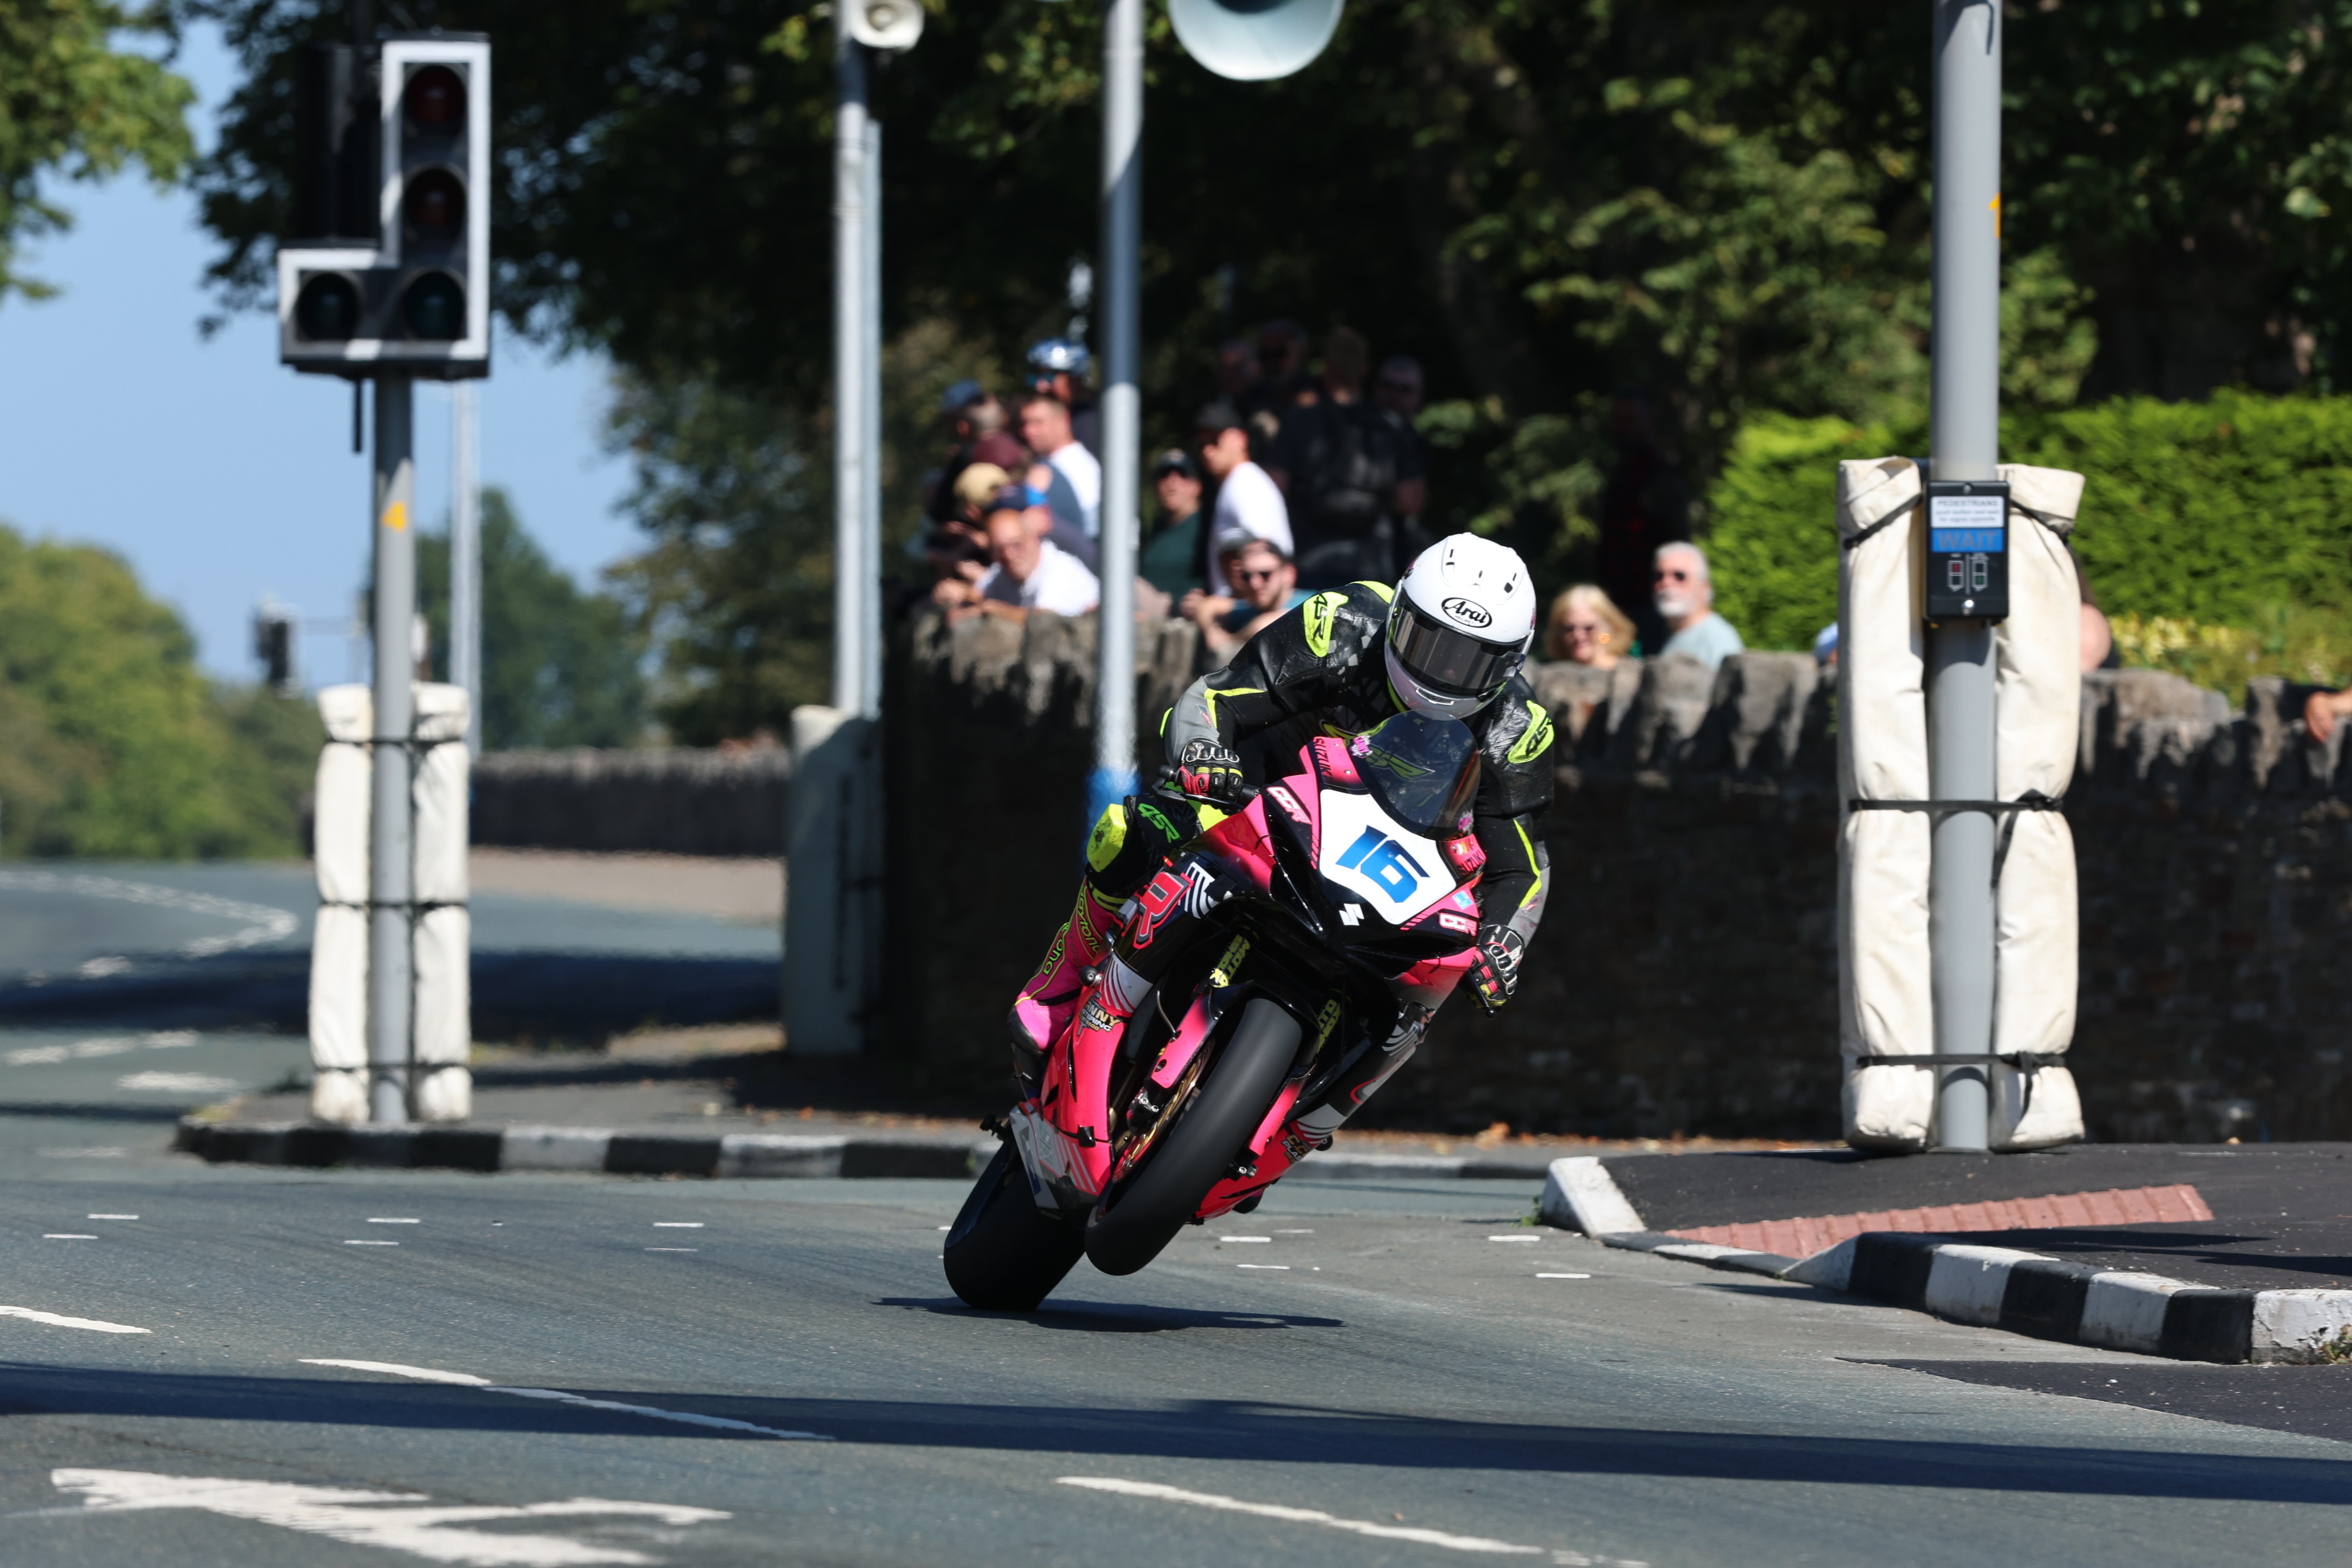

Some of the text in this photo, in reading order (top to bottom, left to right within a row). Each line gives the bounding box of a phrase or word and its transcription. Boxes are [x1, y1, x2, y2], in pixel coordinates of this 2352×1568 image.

[1937, 532, 1998, 549] WAIT
[1443, 601, 1489, 623] Arai
[1266, 786, 1312, 824] CCR
[1138, 803, 1181, 843] 4SR
[1335, 824, 1431, 903] 16
[1439, 913, 1477, 936] CCR
